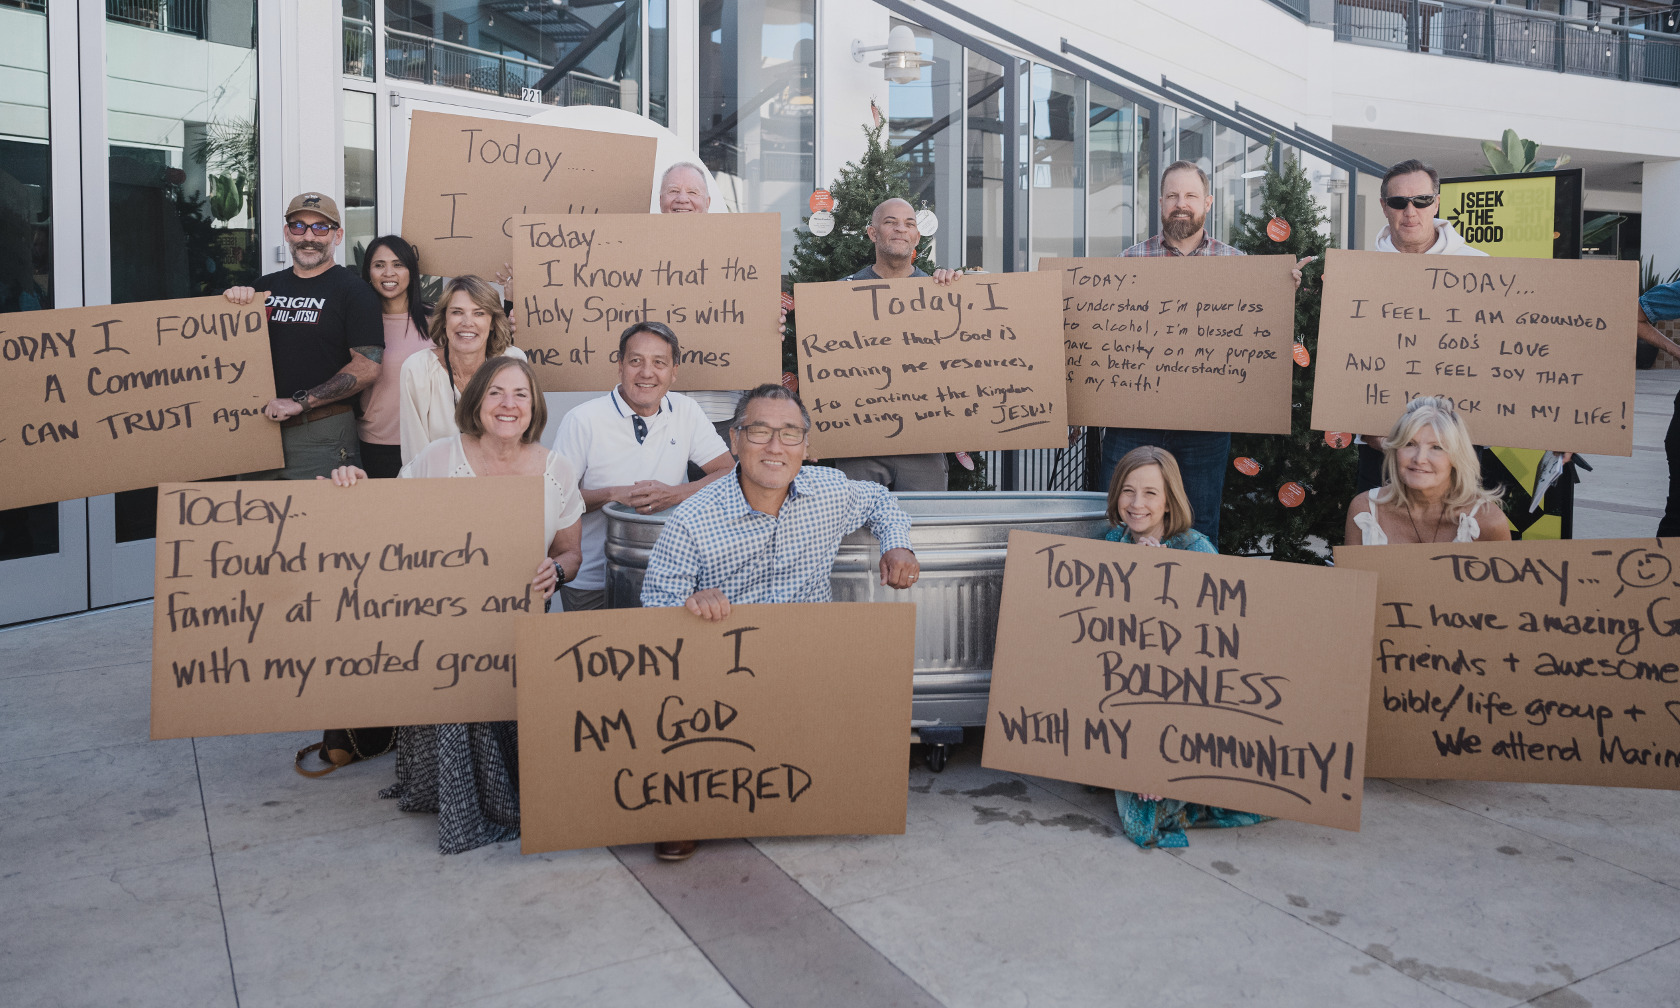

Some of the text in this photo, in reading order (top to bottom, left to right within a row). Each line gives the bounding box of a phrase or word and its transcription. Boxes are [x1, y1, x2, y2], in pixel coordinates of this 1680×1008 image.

[523, 88, 541, 103] 221
[434, 193, 473, 240] I
[1466, 190, 1504, 208] SEEK
[1465, 226, 1503, 243] GOOD
[1466, 209, 1494, 226] THE
[539, 260, 563, 287] I
[651, 259, 708, 286] that
[721, 257, 758, 281] the
[265, 296, 325, 309] ORIGIN
[525, 295, 744, 333] Holy Spirit is with
[976, 283, 1008, 310] I
[1063, 297, 1263, 318] I understand I'm powerless
[272, 309, 319, 322] JIU-JITSU
[1064, 317, 1271, 337] to alcohol, I'm blessed to
[1350, 300, 1606, 330] I FEEL I AM GROUNDED
[0, 329, 76, 362] ODAY
[92, 320, 130, 354] I
[524, 348, 563, 366] me
[570, 336, 595, 365] at
[680, 346, 730, 367] imes
[802, 325, 1016, 357] Realize that God is
[1102, 340, 1154, 360] clarity
[1164, 348, 1184, 356] on
[1195, 348, 1214, 361] my
[1226, 348, 1277, 363] purpose
[1398, 333, 1416, 349] IN
[1500, 341, 1549, 357] LOVE
[45, 355, 246, 403] A Community
[807, 364, 891, 390] loaning
[902, 362, 928, 373] me
[1065, 356, 1081, 367] nd
[1108, 355, 1145, 369] better
[1156, 361, 1246, 384] understanding
[1066, 371, 1160, 393] f my faith!
[1346, 353, 1583, 385] AND I FEEL JOY THAT
[812, 398, 841, 413] to
[855, 393, 928, 407] continue
[936, 386, 969, 402] the
[1367, 383, 1390, 405] HE
[1498, 404, 1515, 416] IN
[1531, 405, 1560, 422] MY
[22, 396, 267, 446] CAN TRUST Agai
[815, 402, 1052, 438] building work of JESUS!
[165, 532, 489, 588] I found my Church
[1035, 544, 1247, 617] TODAY I AM
[286, 592, 320, 622] at
[335, 587, 467, 622] Mariners
[481, 583, 532, 612] and
[1059, 607, 1239, 660] JOINED IN
[1382, 602, 1422, 629] I
[1429, 604, 1508, 630] have
[1518, 609, 1645, 655] amazing
[264, 657, 316, 697] my
[325, 640, 424, 677] rooted
[554, 626, 759, 682] TODAY I
[1376, 639, 1486, 676] friends
[1534, 653, 1679, 683] awesome
[1097, 651, 1290, 715] BOLDNESS
[574, 709, 637, 752] AM
[1525, 698, 1613, 737] group
[999, 706, 1354, 804] WITH MY COMMUNITY!
[1432, 727, 1481, 757] We
[1492, 730, 1582, 762] attend
[614, 763, 812, 813] CENTERED
